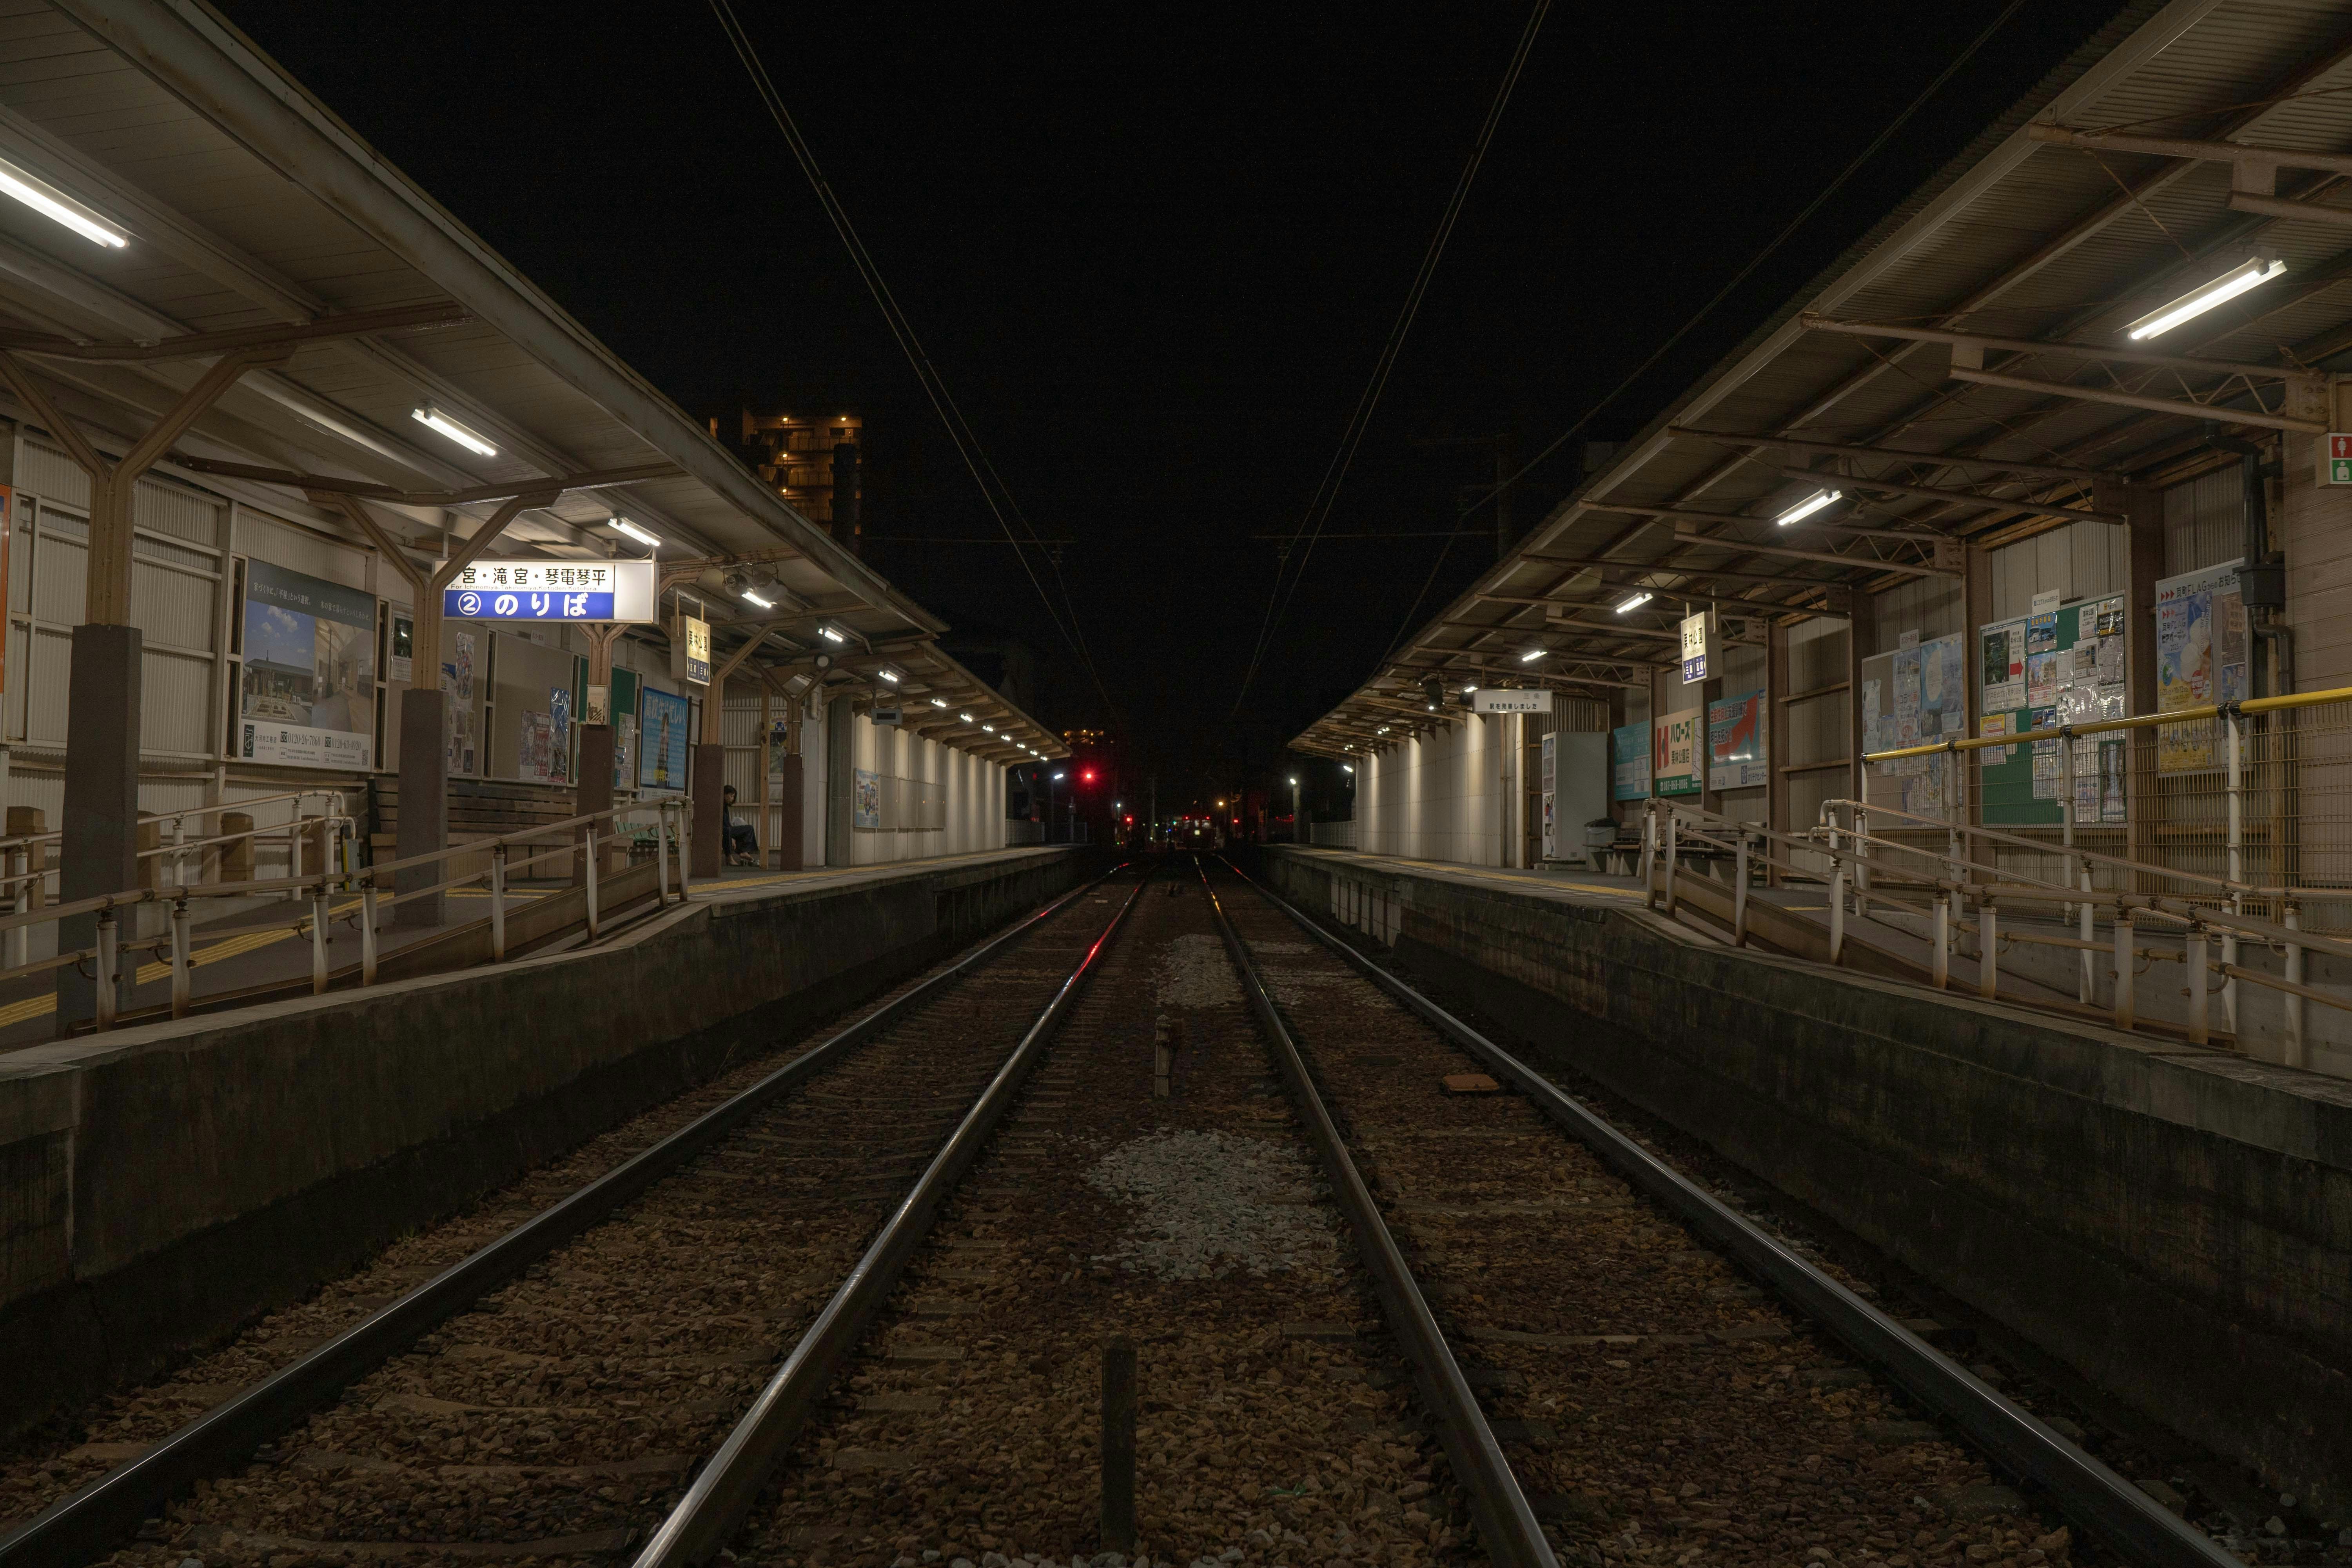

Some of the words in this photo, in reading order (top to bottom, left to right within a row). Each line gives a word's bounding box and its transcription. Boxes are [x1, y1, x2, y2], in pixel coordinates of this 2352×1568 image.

[494, 592, 588, 617] のりば
[689, 630, 707, 652] 栗林公園
[288, 733, 321, 747] 0120-26-7860
[1670, 720, 1691, 744] ハローズ
[331, 738, 361, 751] 0120-63-4920
[1671, 748, 1690, 765] 栗林公園店
